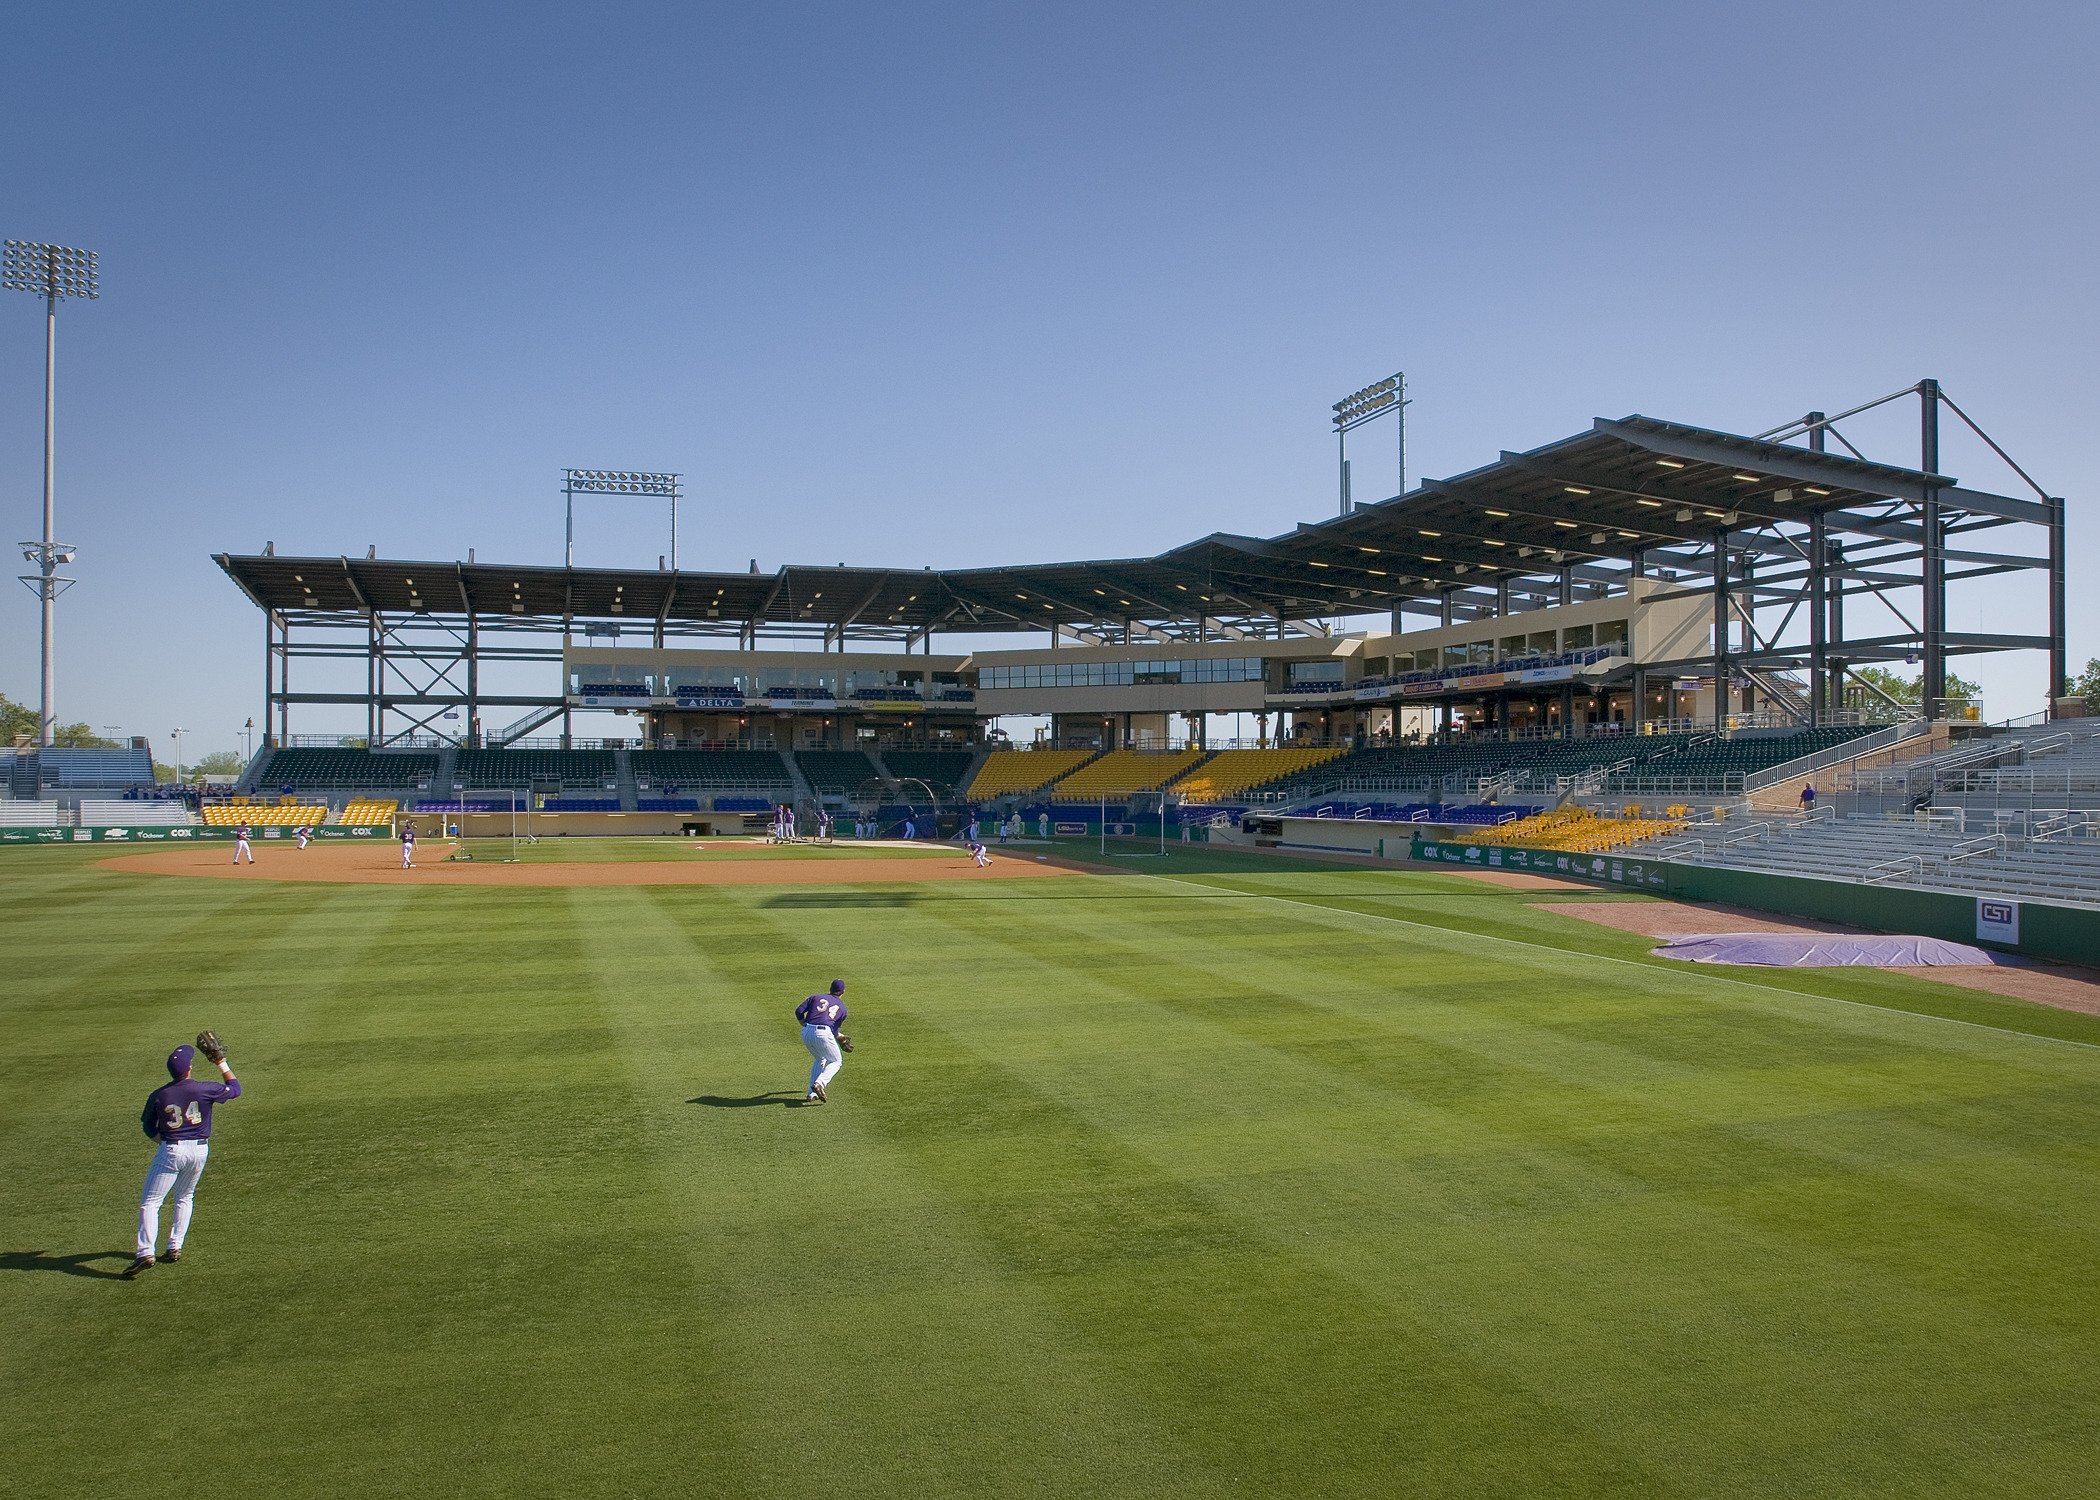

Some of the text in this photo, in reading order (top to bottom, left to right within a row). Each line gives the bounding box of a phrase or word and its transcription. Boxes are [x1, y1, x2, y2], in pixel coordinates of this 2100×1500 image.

[699, 699, 734, 707] DELTA
[170, 828, 193, 837] COX
[351, 827, 373, 836] COX
[1424, 846, 1438, 858] COX
[1557, 857, 1568, 870] COX
[1984, 905, 2010, 921] CST
[816, 998, 840, 1020] 34
[164, 1100, 202, 1129] 34
